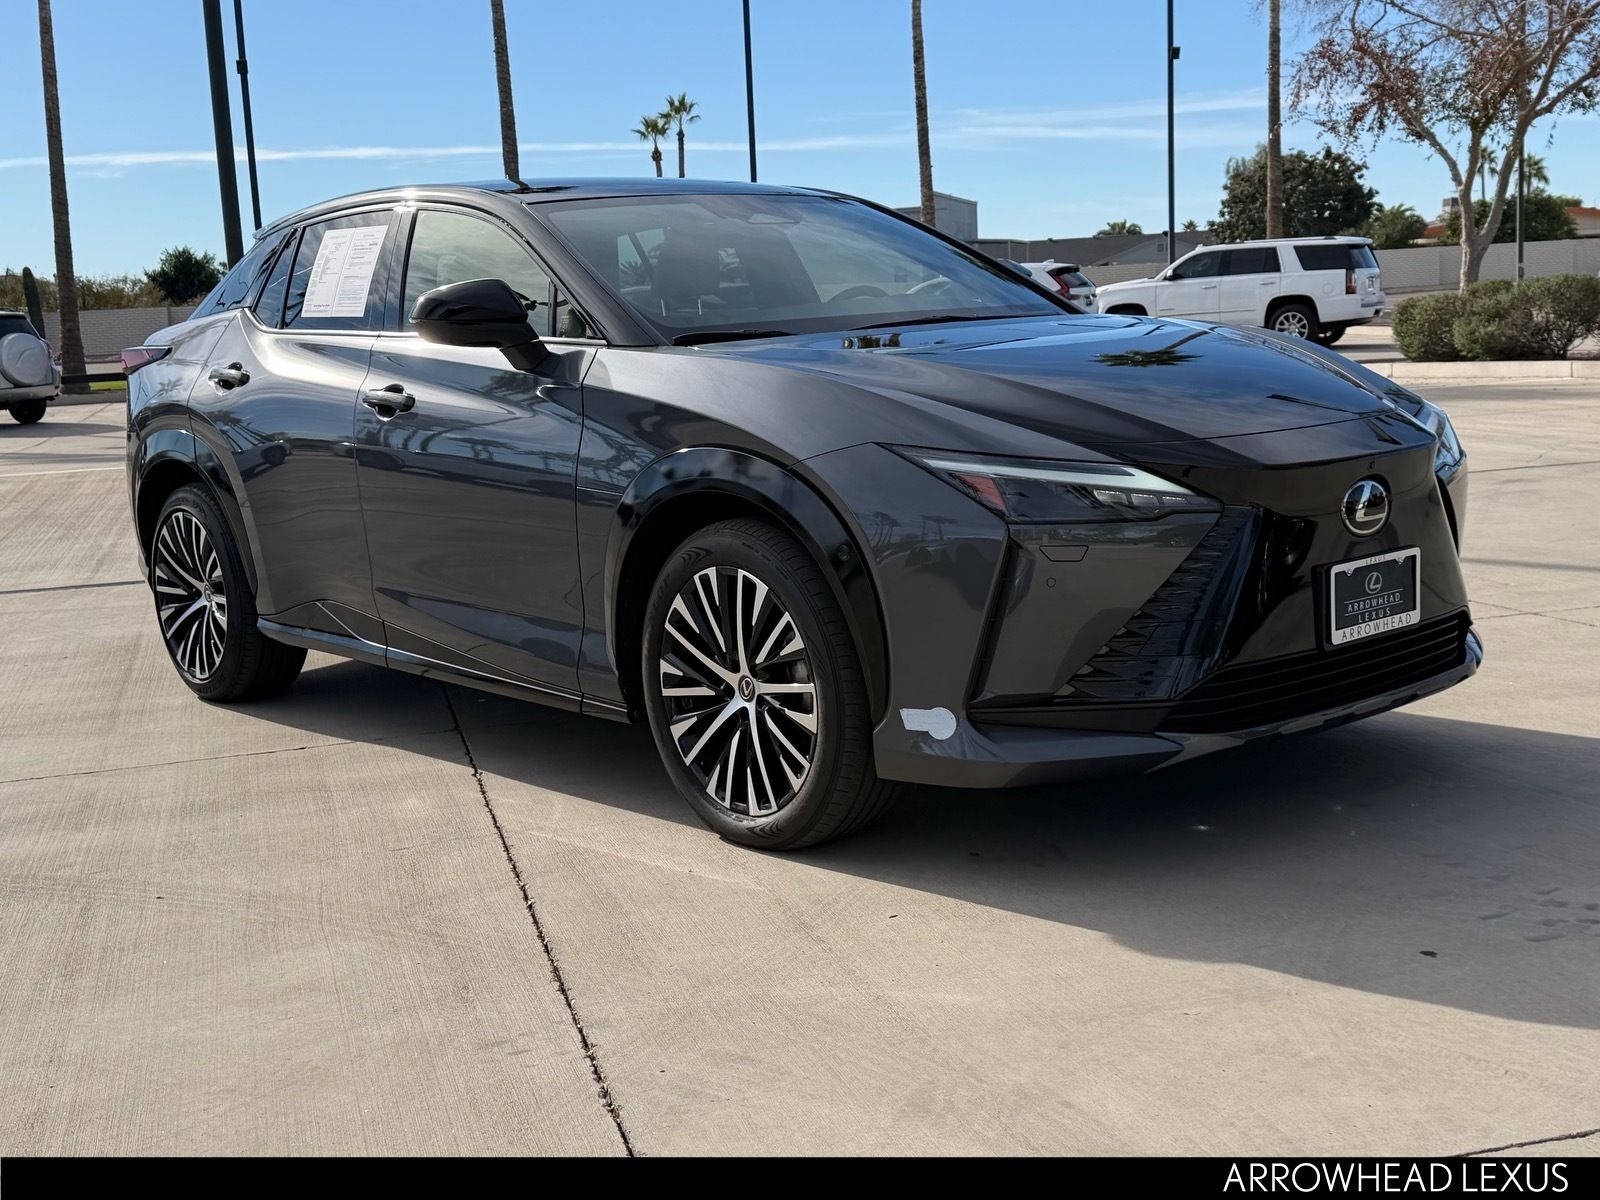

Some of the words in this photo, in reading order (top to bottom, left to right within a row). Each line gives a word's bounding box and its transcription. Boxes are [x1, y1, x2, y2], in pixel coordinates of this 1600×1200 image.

[1347, 592, 1401, 613] ARROWHEAD
[1358, 607, 1391, 623] LEXUS
[1341, 613, 1412, 642] ARROWHEAD
